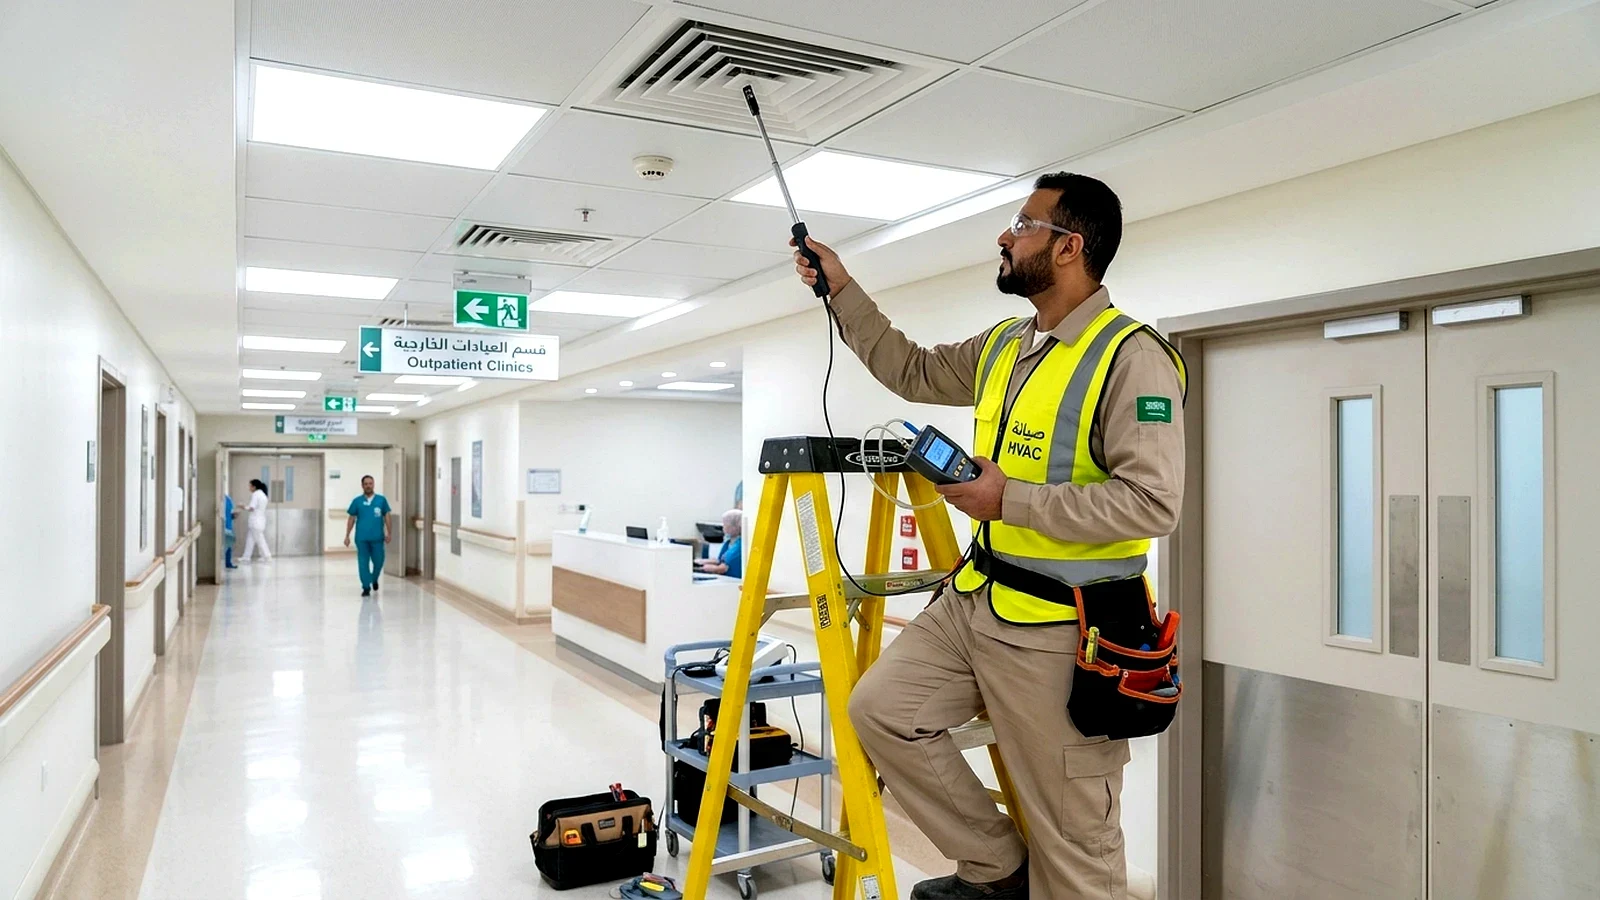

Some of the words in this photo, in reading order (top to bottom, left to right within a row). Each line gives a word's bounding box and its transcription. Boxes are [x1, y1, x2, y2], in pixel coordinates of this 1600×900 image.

[393, 335, 448, 353] الخارجية
[452, 339, 507, 355] العيادات
[511, 344, 546, 358] قسم
[407, 356, 482, 371] Outpatient
[487, 360, 533, 373] Clinics
[1007, 441, 1042, 460] HVAC
